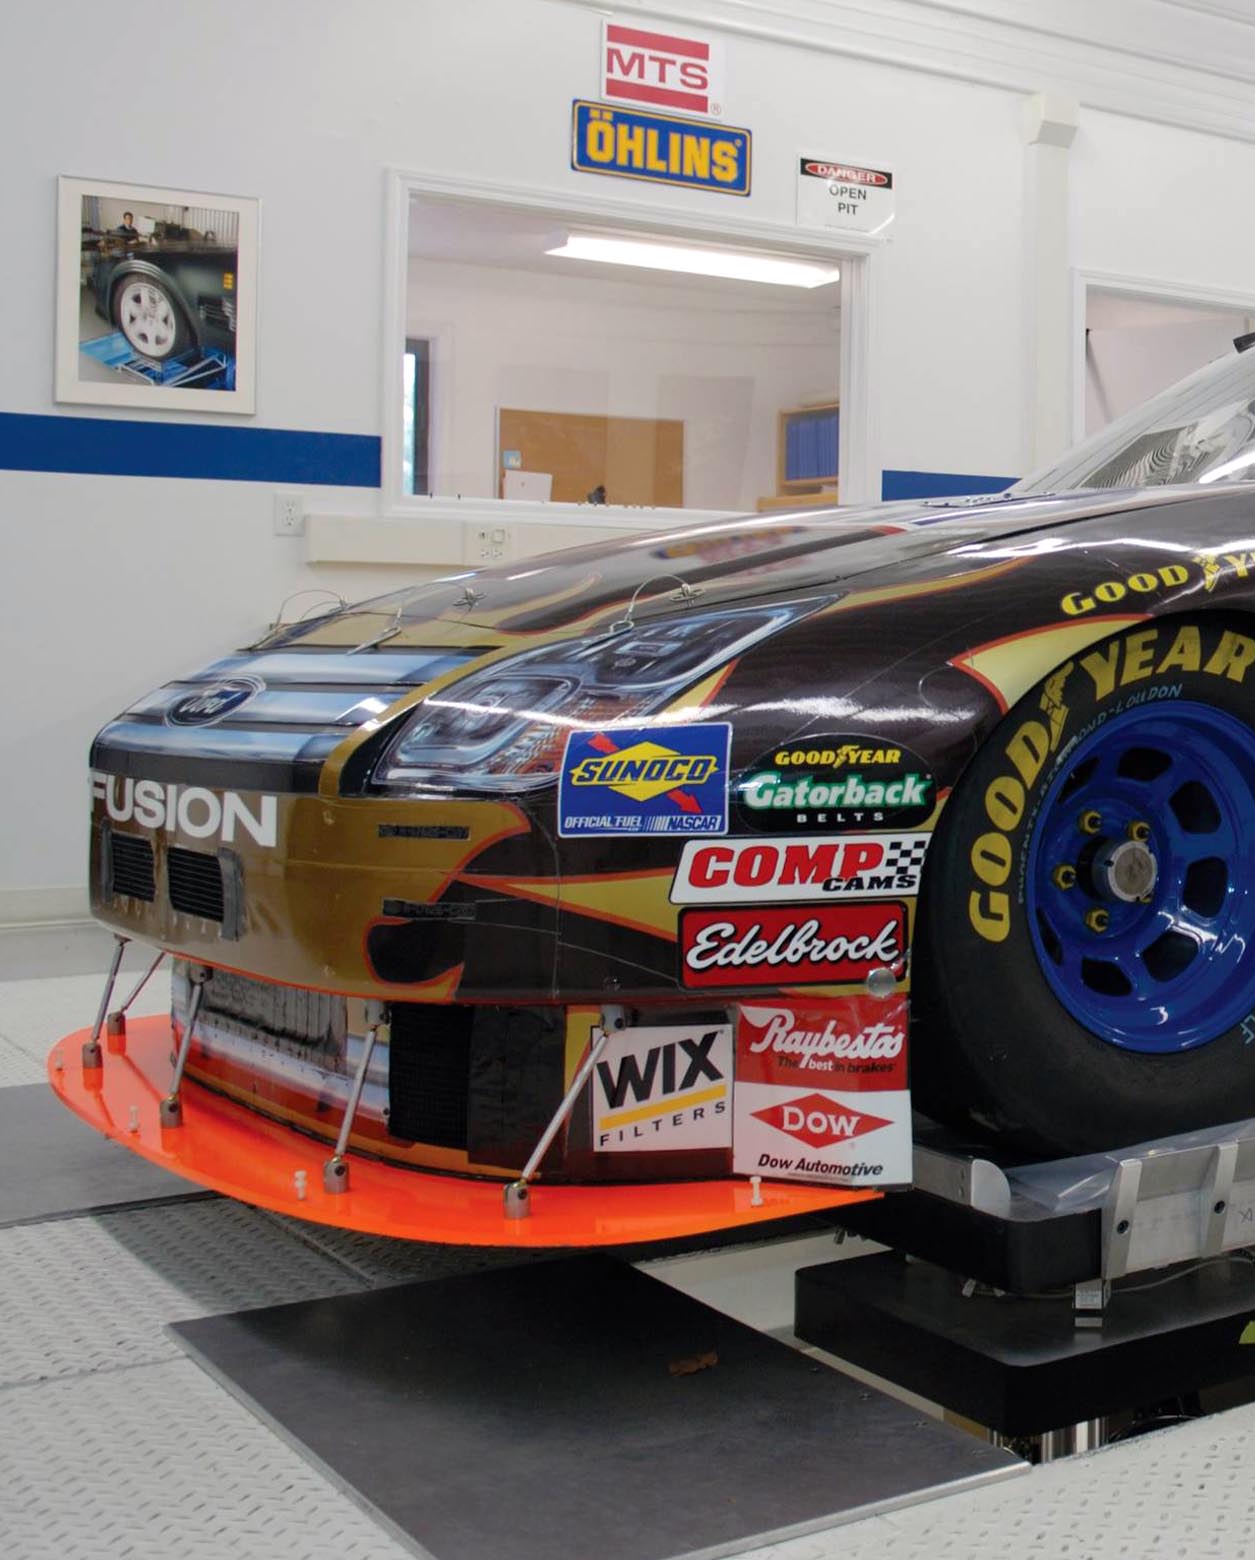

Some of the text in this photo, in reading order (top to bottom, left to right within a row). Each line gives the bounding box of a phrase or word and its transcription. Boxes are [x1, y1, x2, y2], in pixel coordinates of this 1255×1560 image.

[606, 47, 709, 91] MTS
[586, 109, 739, 183] ÖHLINS
[817, 165, 876, 183] DANGER
[829, 184, 867, 200] OPEN
[838, 202, 859, 215] PIT
[576, 758, 713, 783] SUNOCO
[743, 770, 932, 811] Gatorback
[90, 774, 278, 847] FUSION
[564, 815, 720, 831] OFFICIAL FUEL NASCAR
[796, 811, 885, 823] BELTS
[688, 842, 885, 889] COMP
[821, 874, 917, 892] CAMS
[686, 918, 900, 970] Edelbrock
[740, 1006, 906, 1070] Raybestos
[596, 1030, 724, 1109] WIX
[778, 1057, 895, 1073] The best in brakes
[600, 1100, 727, 1147] FILTERS
[758, 1153, 884, 1176] Dow Automotive
